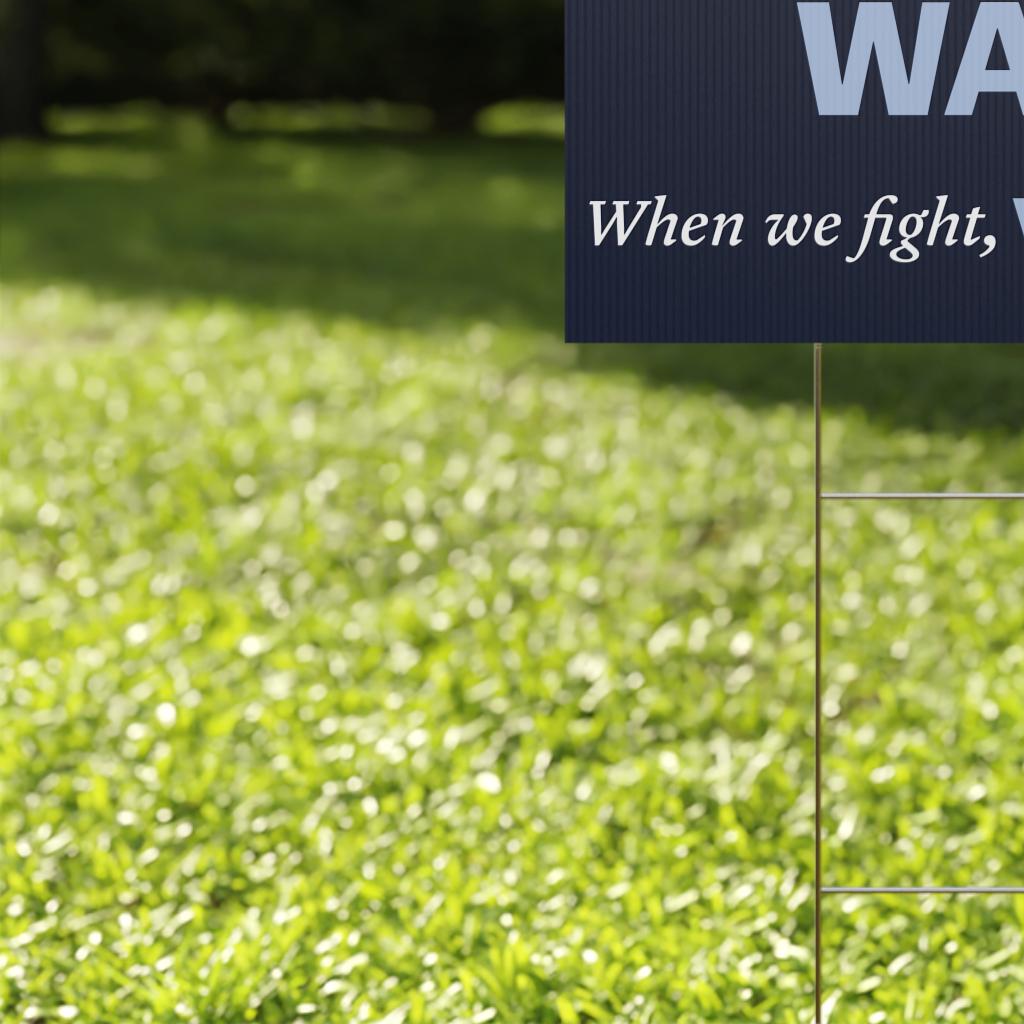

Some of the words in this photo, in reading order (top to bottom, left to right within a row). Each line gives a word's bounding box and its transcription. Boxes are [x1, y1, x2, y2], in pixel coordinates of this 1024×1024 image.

[589, 195, 744, 247] When
[765, 213, 842, 247] we
[846, 195, 998, 263] fight,
